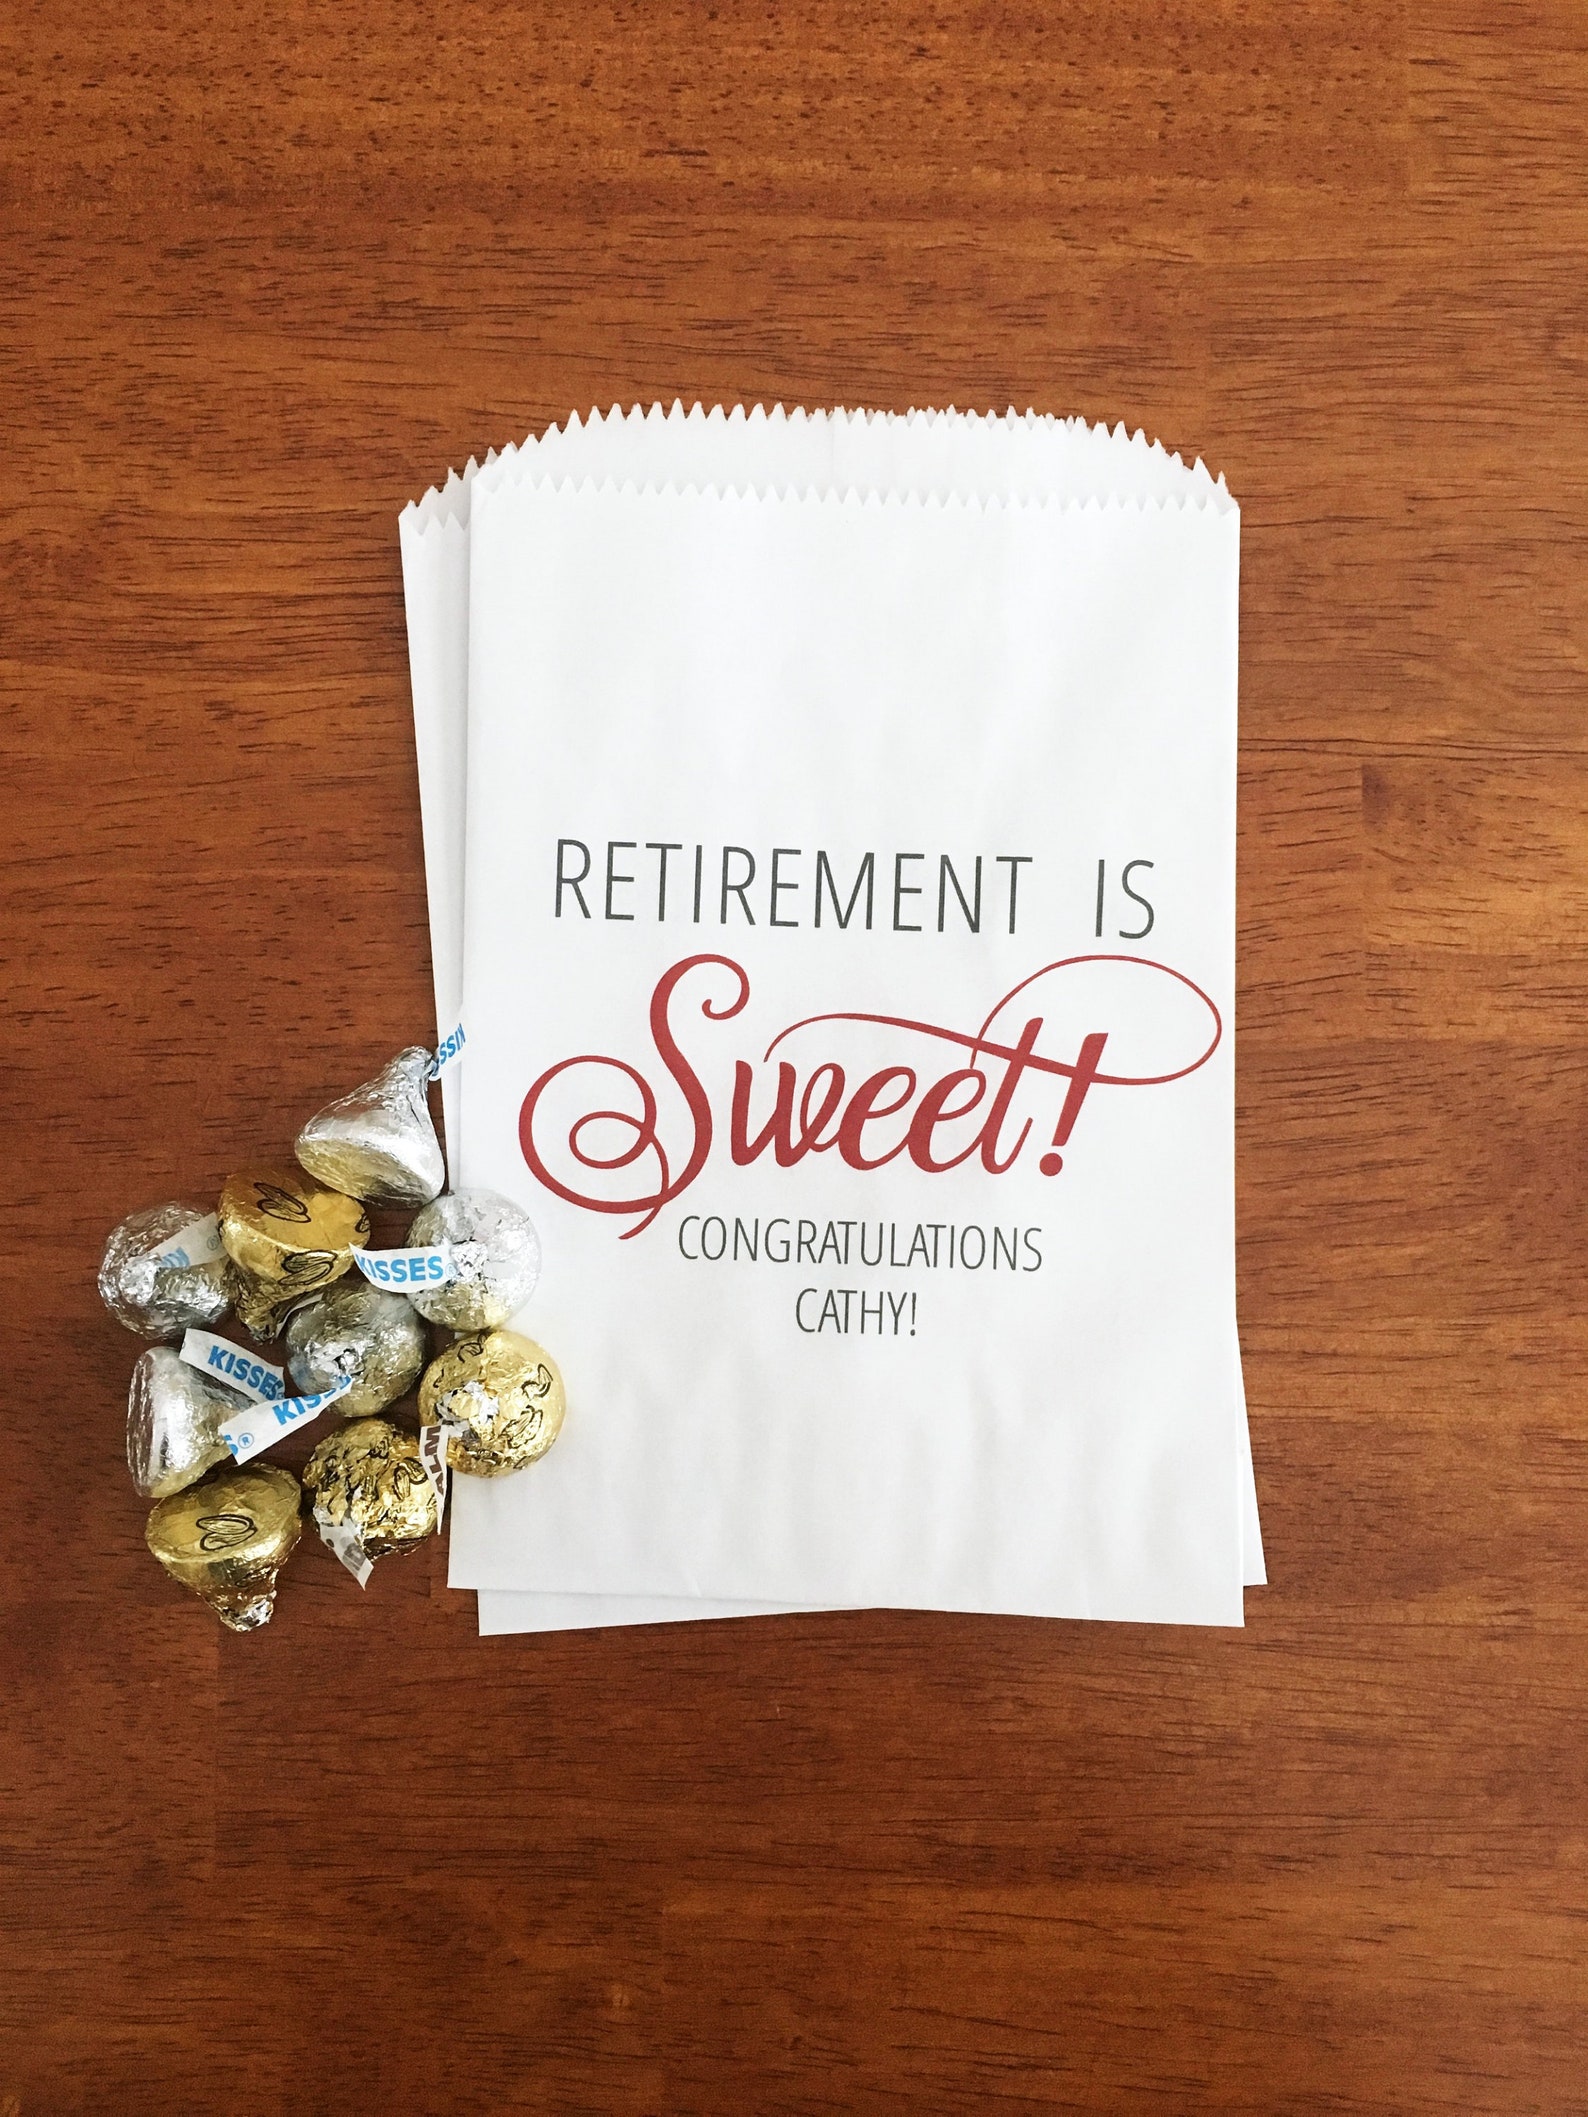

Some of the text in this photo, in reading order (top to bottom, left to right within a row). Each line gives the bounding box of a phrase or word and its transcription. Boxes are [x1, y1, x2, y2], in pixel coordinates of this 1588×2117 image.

[554, 838, 1155, 940] RETIREMENT IS
[518, 953, 1223, 1241] Sweet!
[678, 1215, 1043, 1273] CONGRATULATIONS
[795, 1287, 917, 1337] CATHY!
